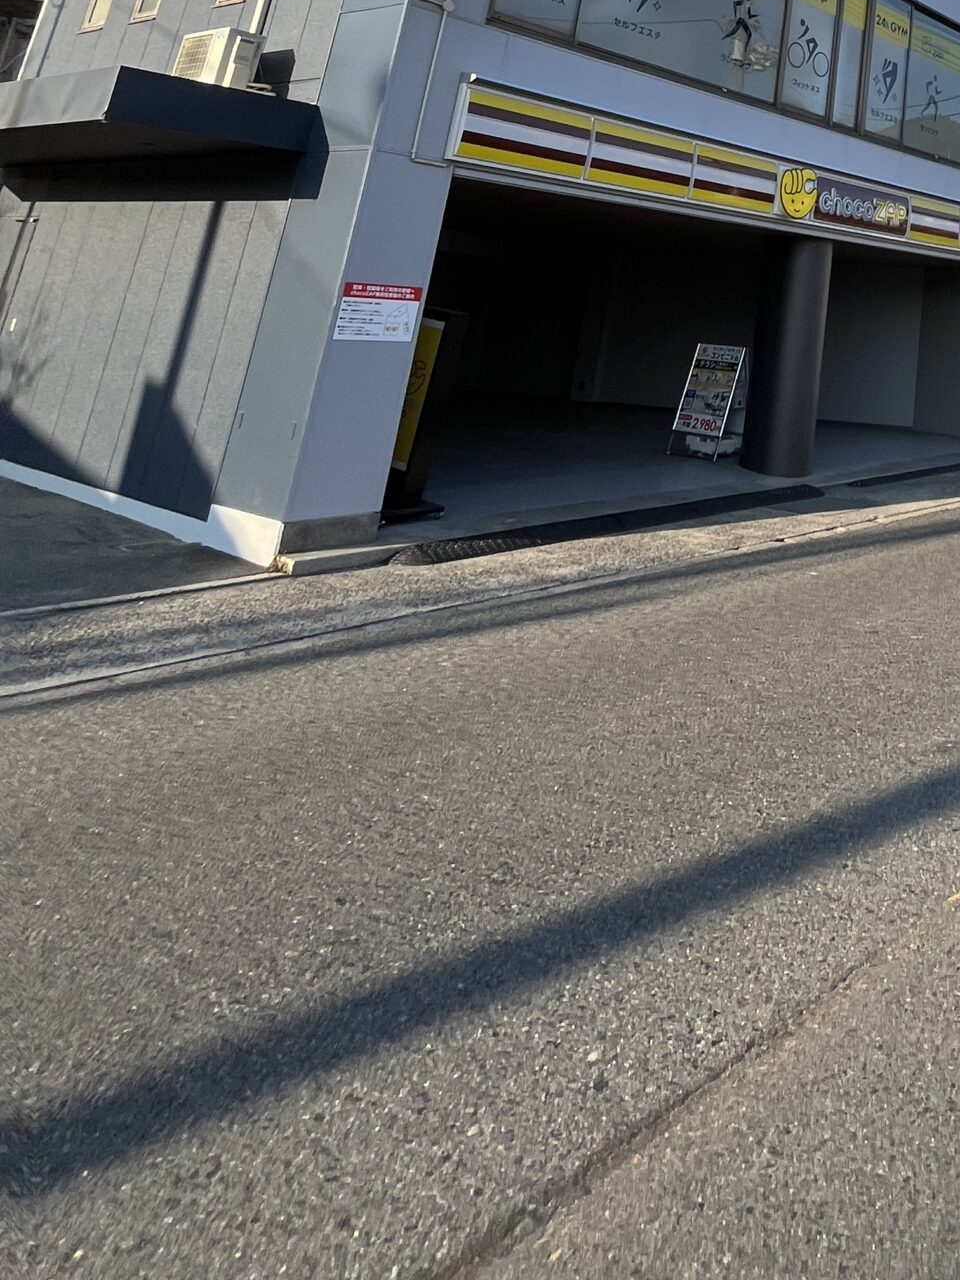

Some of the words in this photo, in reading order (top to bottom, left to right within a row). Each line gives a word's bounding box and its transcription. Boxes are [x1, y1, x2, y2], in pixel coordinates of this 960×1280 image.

[612, 16, 664, 41] セルフエステ
[876, 14, 890, 30] 24h
[890, 20, 909, 40] GYM
[792, 77, 821, 95] フィットネス
[818, 187, 909, 228] chocoZAP
